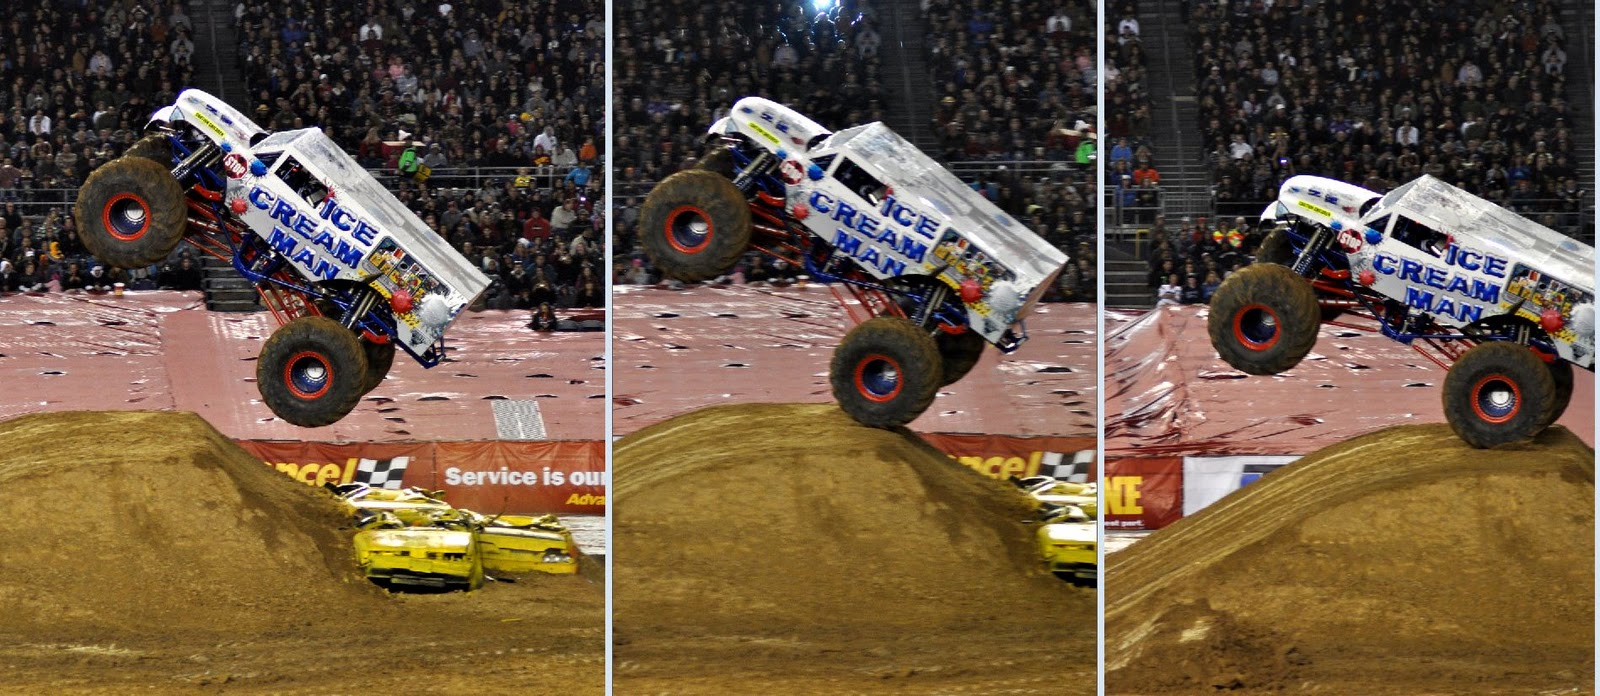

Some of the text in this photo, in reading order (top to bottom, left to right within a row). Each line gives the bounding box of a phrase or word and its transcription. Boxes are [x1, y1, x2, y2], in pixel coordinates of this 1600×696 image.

[224, 155, 246, 176] STOP
[249, 185, 367, 269] CREAM
[319, 197, 380, 247] ICE
[808, 189, 929, 264] CREAM
[880, 194, 941, 240] ICE
[1339, 231, 1362, 250] STOP
[267, 225, 342, 281] MAN
[832, 227, 907, 277] MAN
[1445, 243, 1509, 279] ICE
[1372, 250, 1502, 305] CREAM
[1405, 285, 1484, 323] MAN
[445, 466, 537, 486] Service
[542, 467, 565, 486] is
